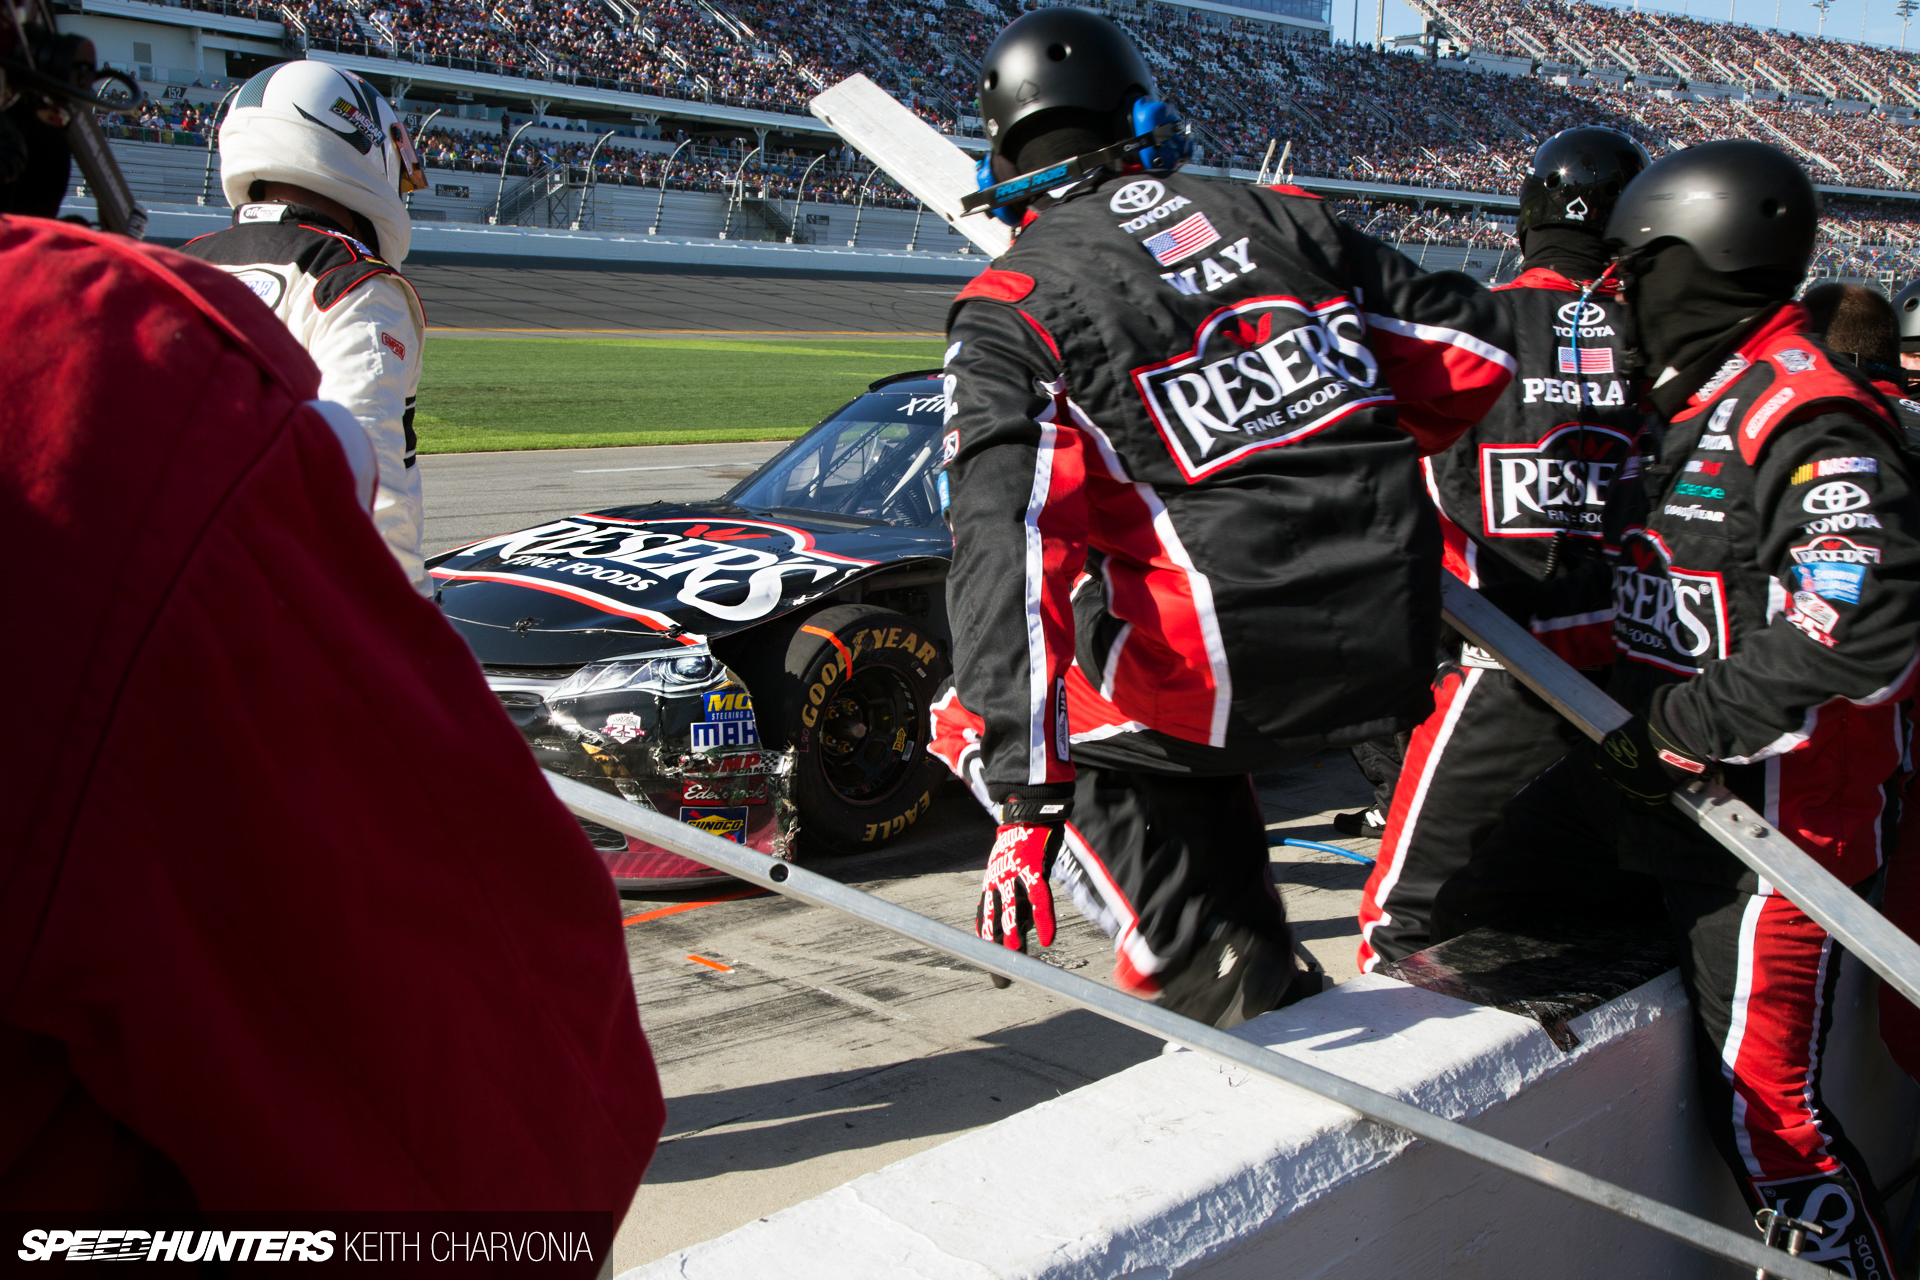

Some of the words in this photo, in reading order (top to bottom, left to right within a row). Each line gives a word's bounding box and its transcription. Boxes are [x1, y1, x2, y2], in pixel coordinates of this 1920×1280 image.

[168, 88, 181, 98] 152
[332, 106, 380, 145] OFFICIAL
[352, 108, 383, 140] NASCAR
[407, 115, 418, 126] 151
[995, 177, 1031, 199] RACING
[1118, 195, 1193, 234] TOYOTA
[1159, 238, 1257, 296] WAY
[1522, 378, 1630, 406] PEGRA
[1242, 411, 1286, 435] FINE
[1286, 381, 1349, 420] FOODS
[1498, 458, 1618, 525] RESE
[1800, 513, 1883, 534] TOYOTA
[502, 554, 563, 570] FINE
[561, 560, 659, 592] FOODS
[712, 711, 744, 720] STEERING
[610, 724, 637, 738] 25
[737, 765, 772, 775] CAMS
[862, 791, 931, 842] EAGLE
